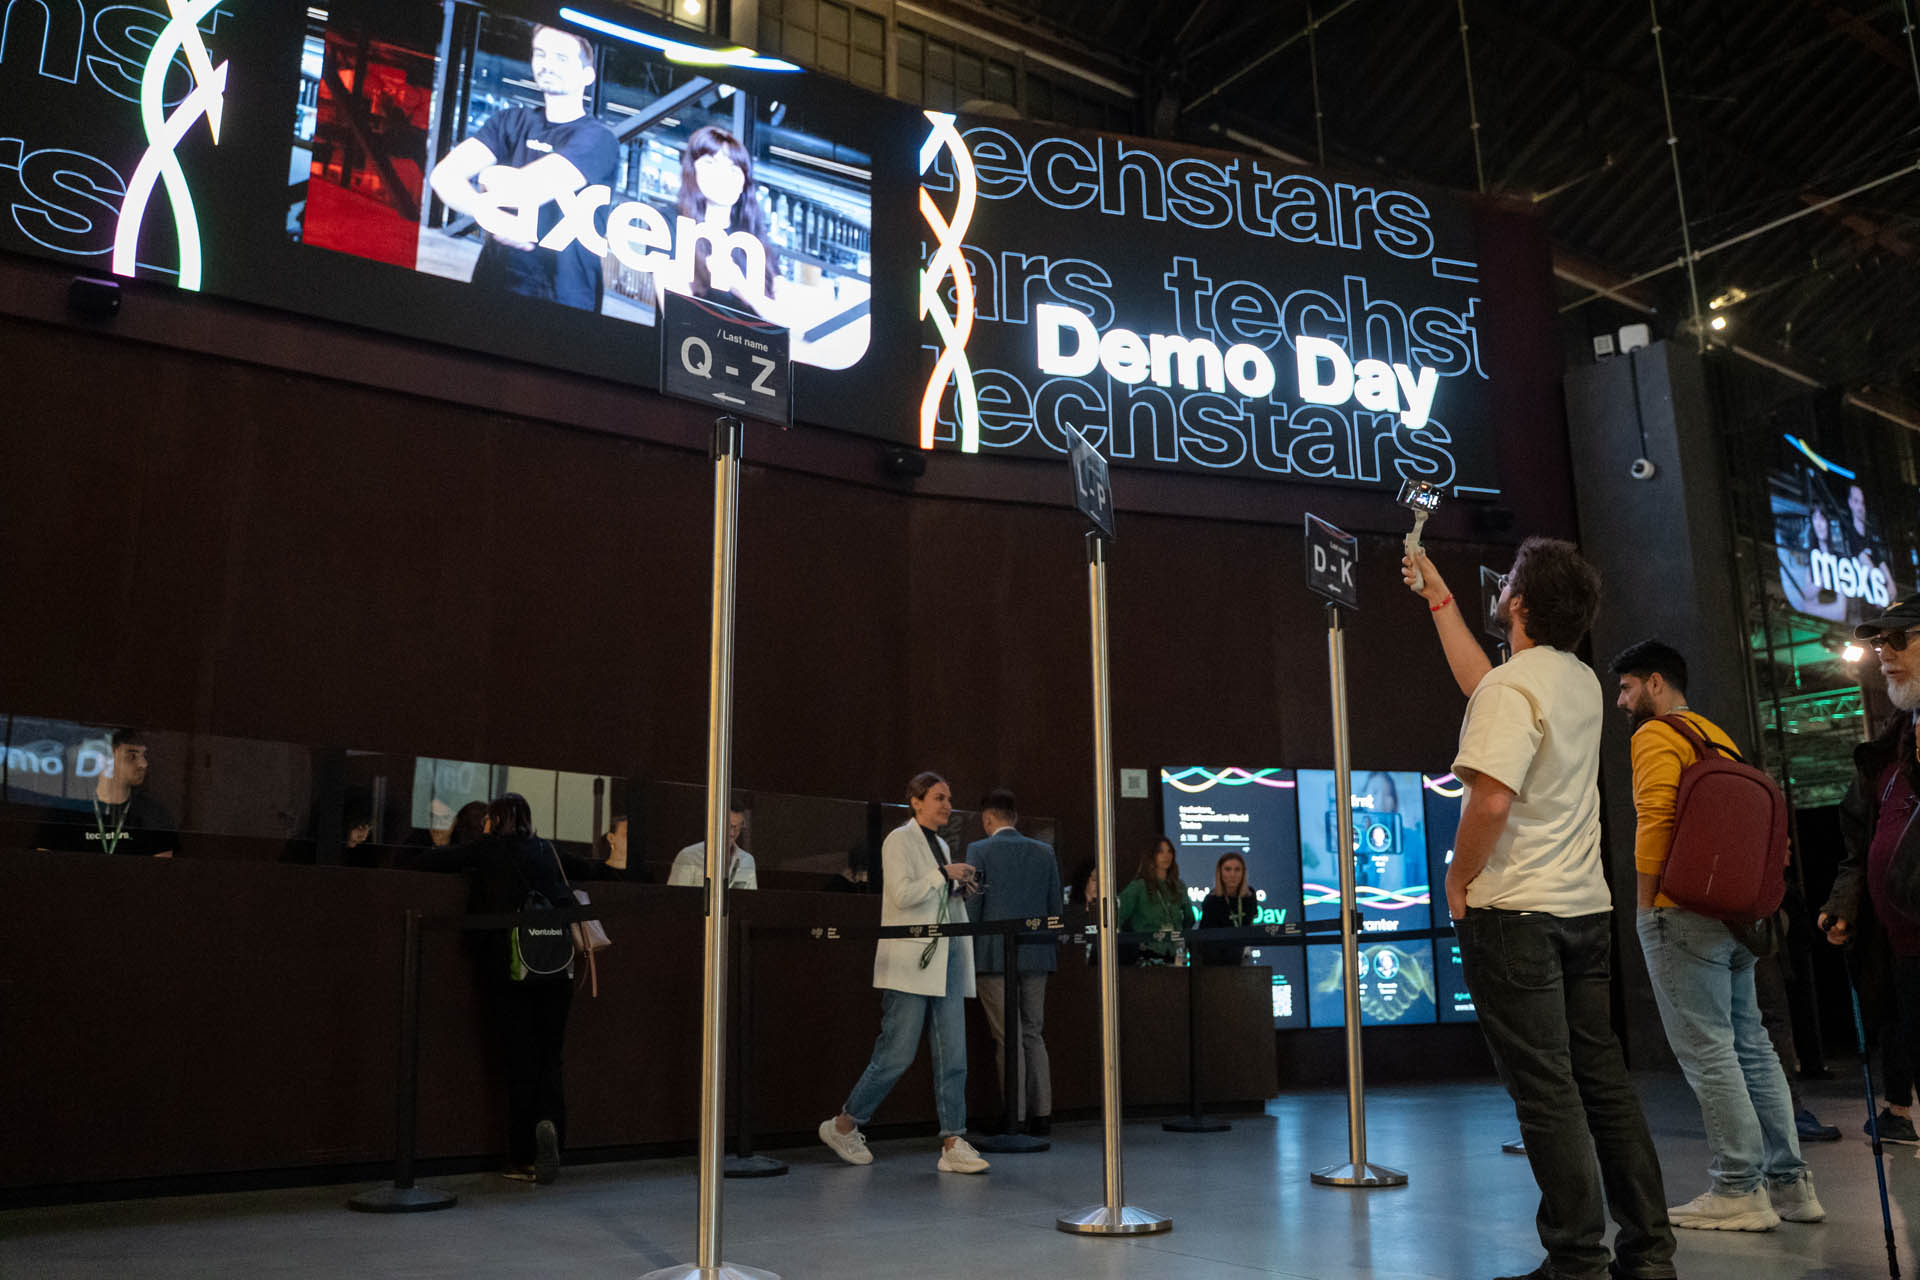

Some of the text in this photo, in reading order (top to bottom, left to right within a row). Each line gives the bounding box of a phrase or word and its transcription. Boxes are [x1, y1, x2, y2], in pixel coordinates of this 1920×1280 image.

[920, 240, 1116, 332] ars
[681, 336, 712, 379] Q
[751, 355, 776, 397] Z
[722, 330, 742, 345] Last
[744, 338, 769, 353] name
[1036, 304, 1440, 430] Demo Day
[1313, 543, 1327, 573] D
[1340, 557, 1354, 588] K
